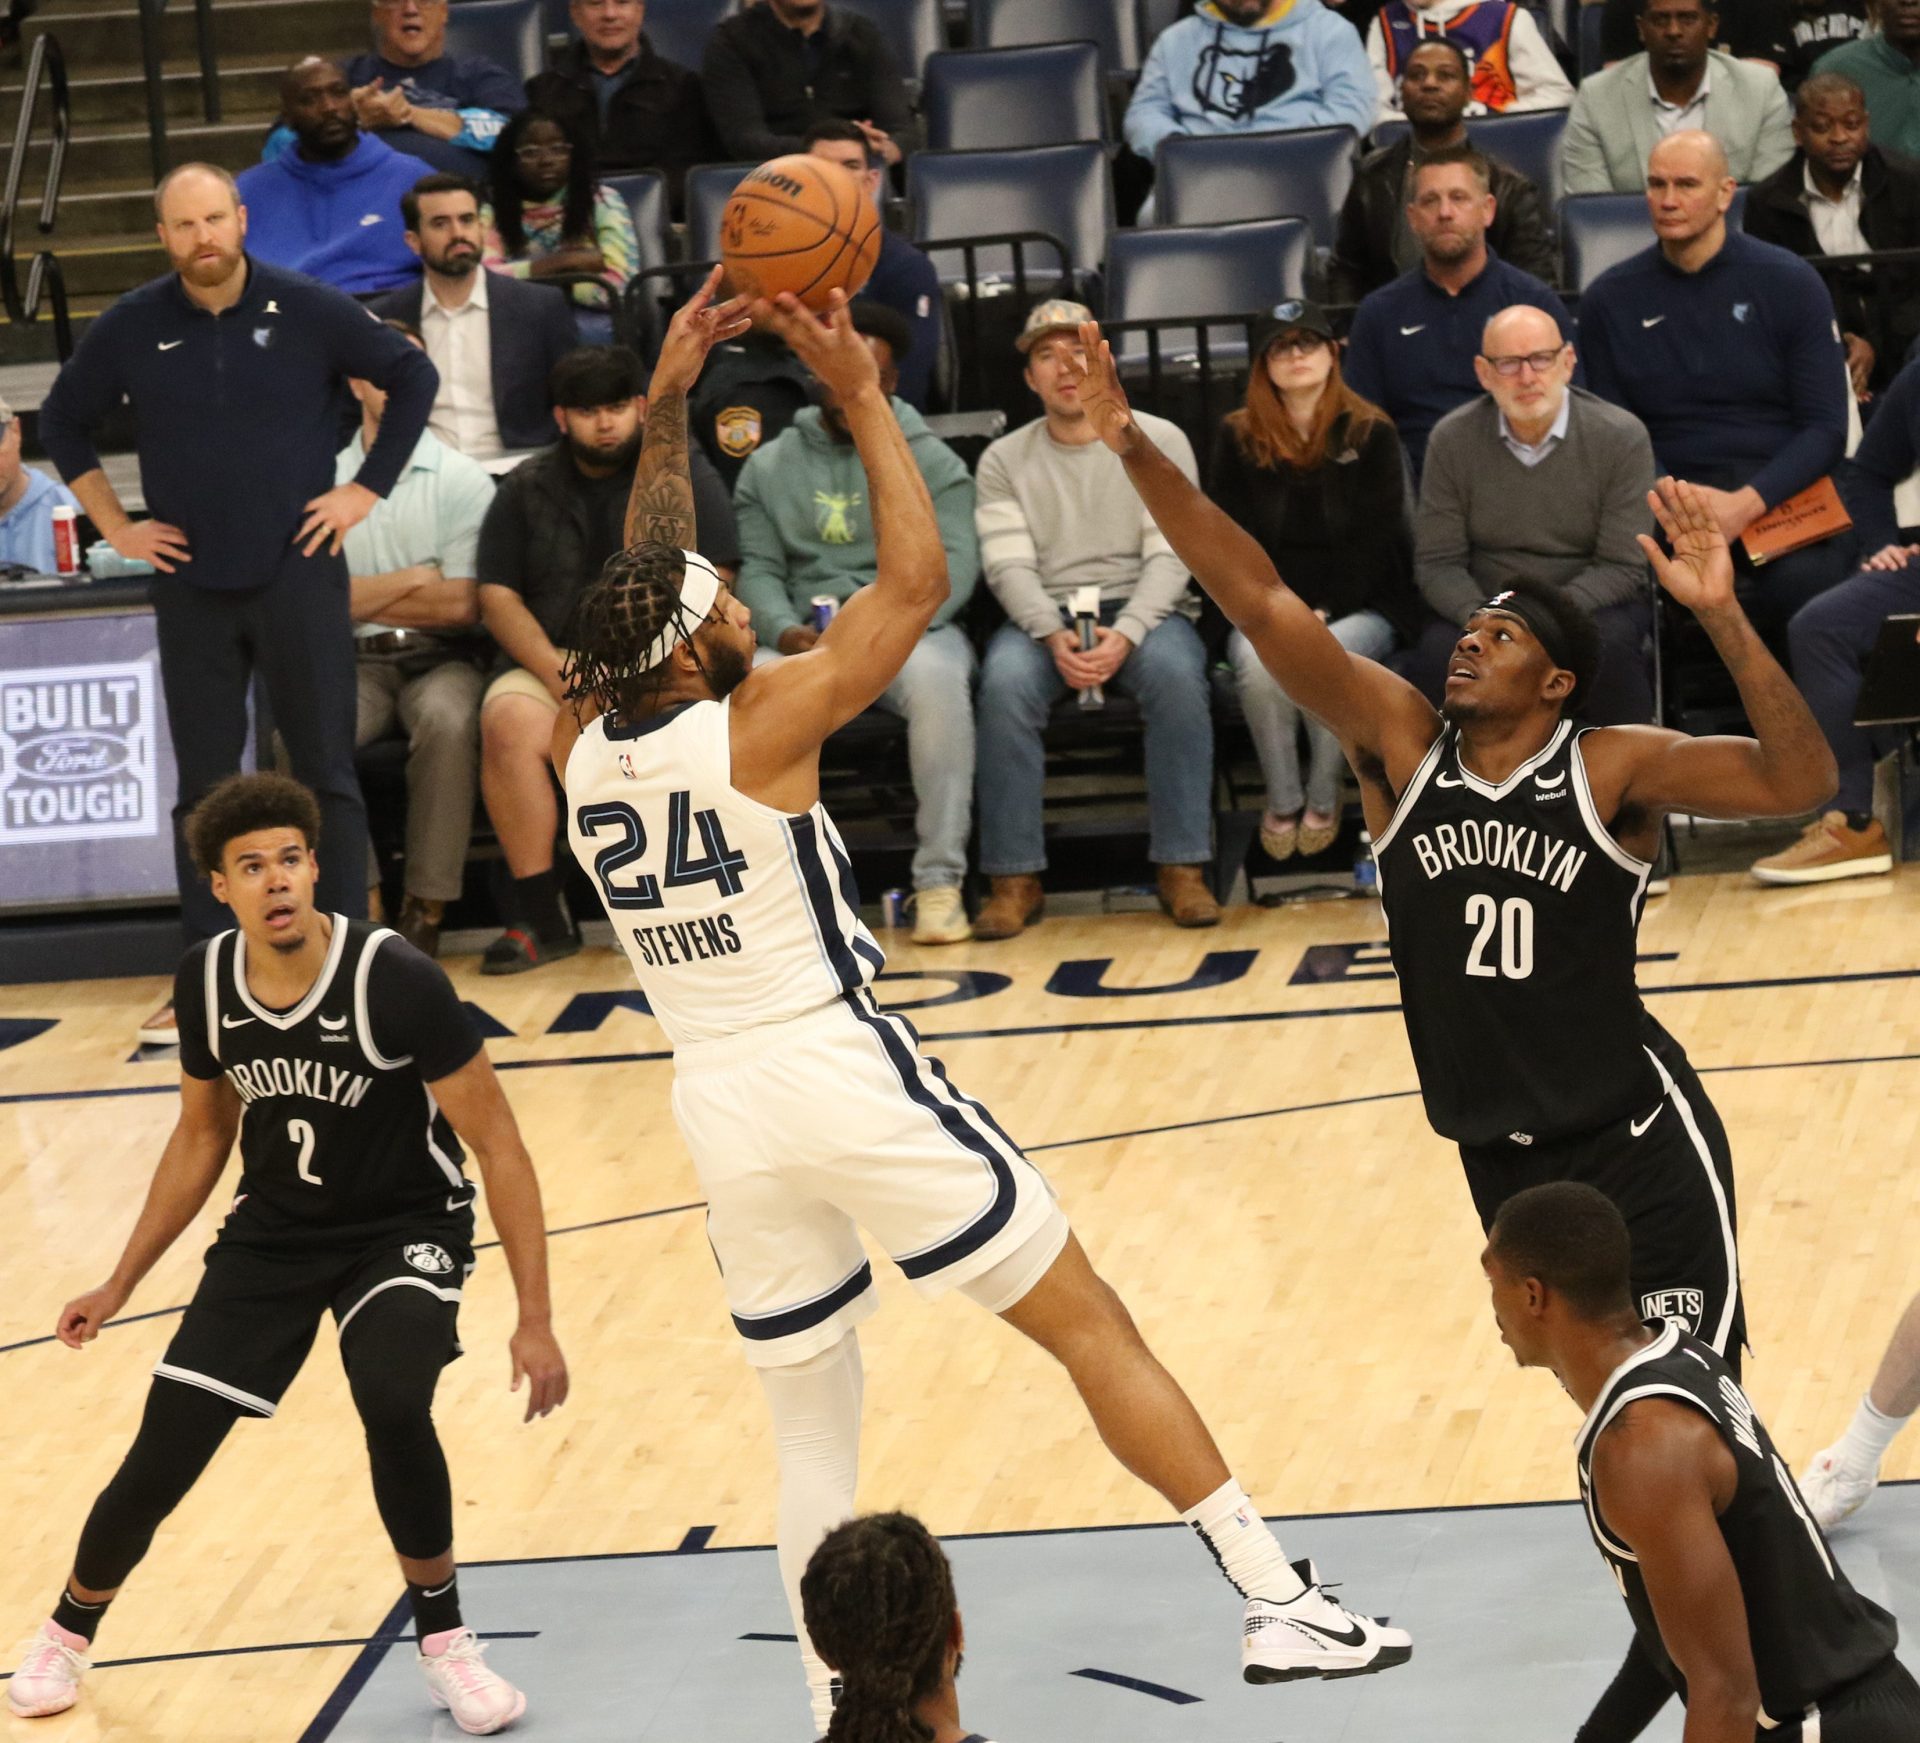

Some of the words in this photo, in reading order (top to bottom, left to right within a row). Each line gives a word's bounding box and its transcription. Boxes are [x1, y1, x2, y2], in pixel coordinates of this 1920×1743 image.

[5, 680, 137, 733] BUILT
[34, 740, 109, 772] Ford
[6, 782, 139, 826] TOUGH
[1535, 788, 1567, 802] Webull
[577, 790, 749, 910] 24
[1412, 819, 1588, 893] BROOKLYN
[632, 913, 742, 966] STEVENS
[1465, 893, 1534, 980] 20
[225, 1057, 373, 1108] BROOKLYN
[287, 1118, 323, 1186] 2
[1645, 1291, 1701, 1319] NETS
